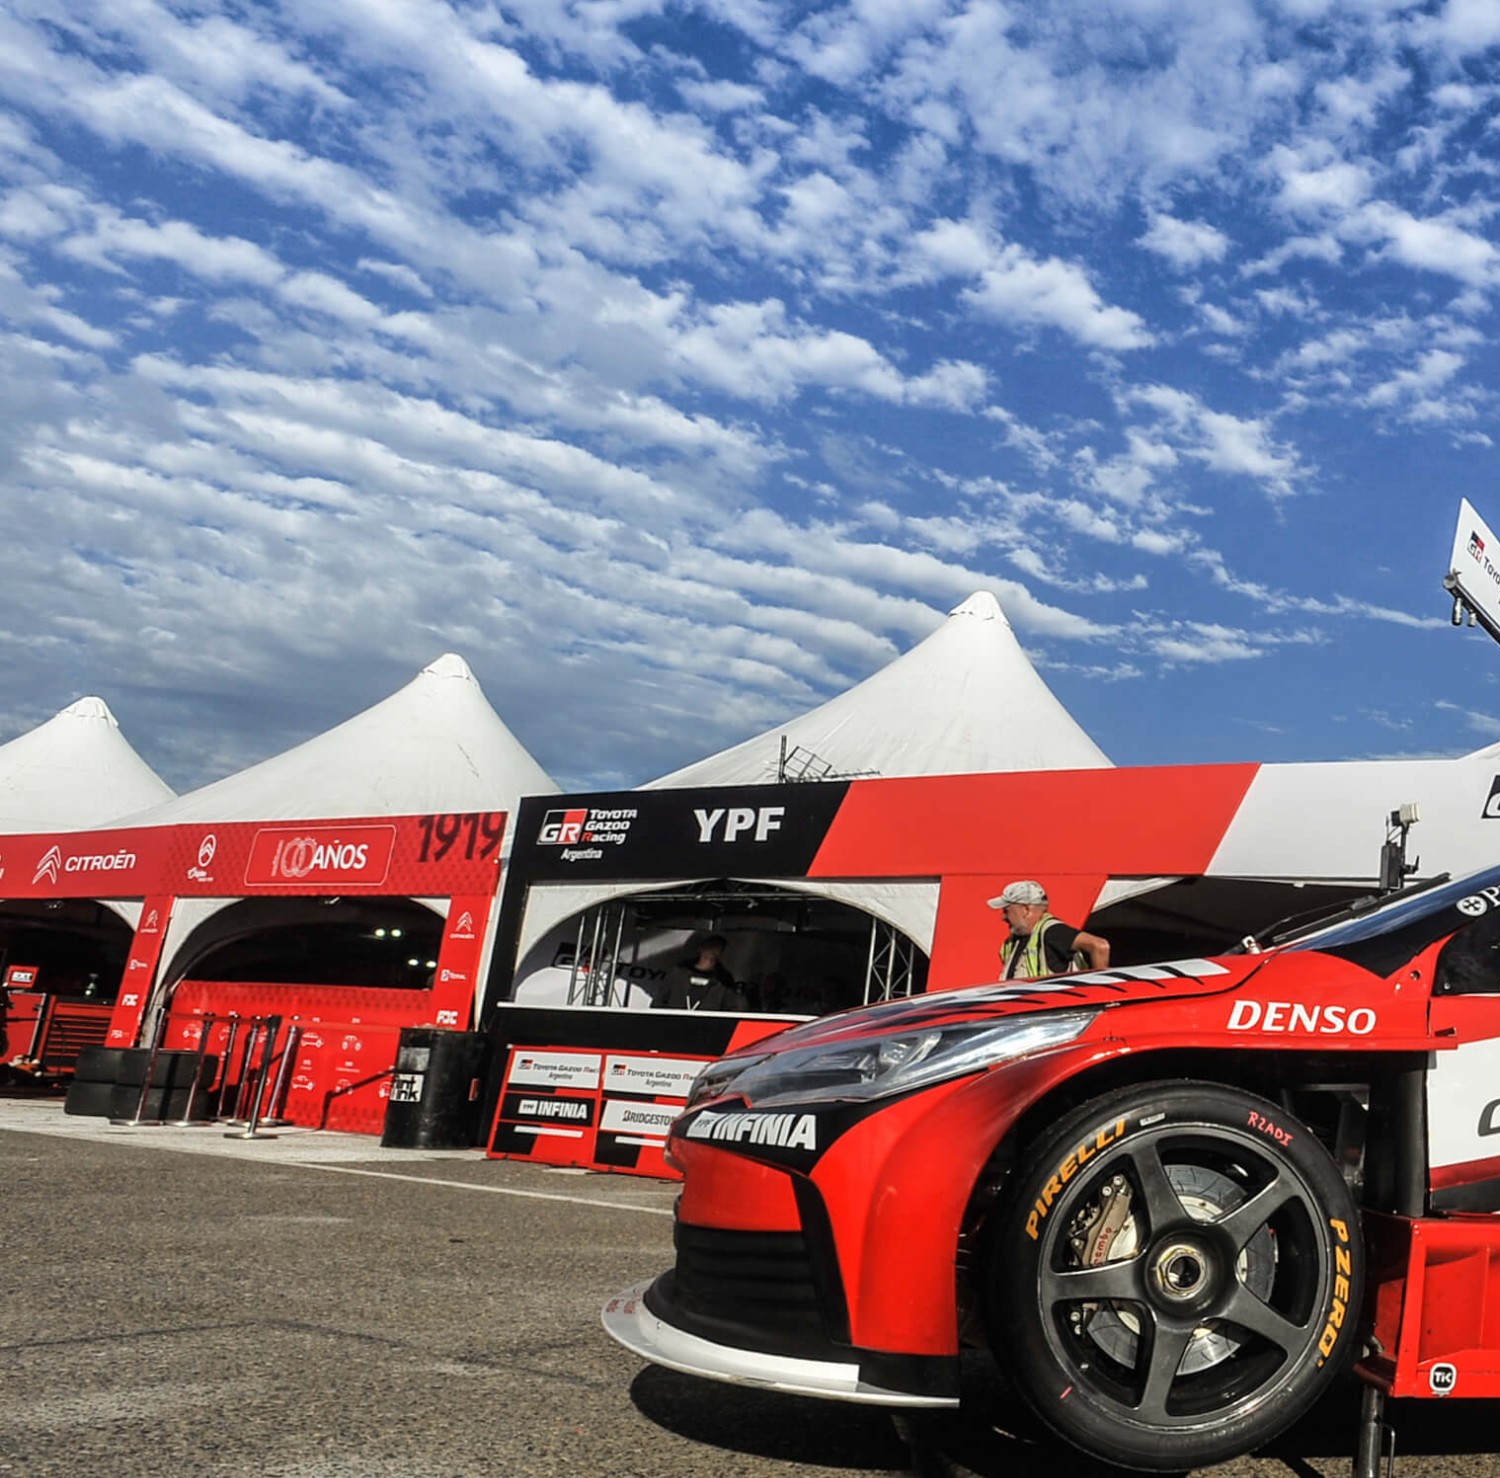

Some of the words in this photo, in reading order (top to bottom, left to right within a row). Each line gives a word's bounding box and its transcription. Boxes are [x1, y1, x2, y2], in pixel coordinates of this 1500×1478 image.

[584, 820, 631, 832] GAZOO
[589, 808, 638, 821] TOYOTA
[693, 806, 786, 843] YPF
[416, 815, 504, 863] 1919
[581, 831, 627, 845] Racing
[309, 839, 369, 870] AÑOS
[560, 847, 603, 862] Argentina
[1226, 999, 1377, 1035] DENSO
[537, 1100, 588, 1120] INFINIA
[711, 1112, 817, 1151] INFINIA
[1025, 1118, 1126, 1241] PIRELLI
[1329, 1217, 1350, 1243] P
[1318, 1245, 1352, 1358] ZERO
